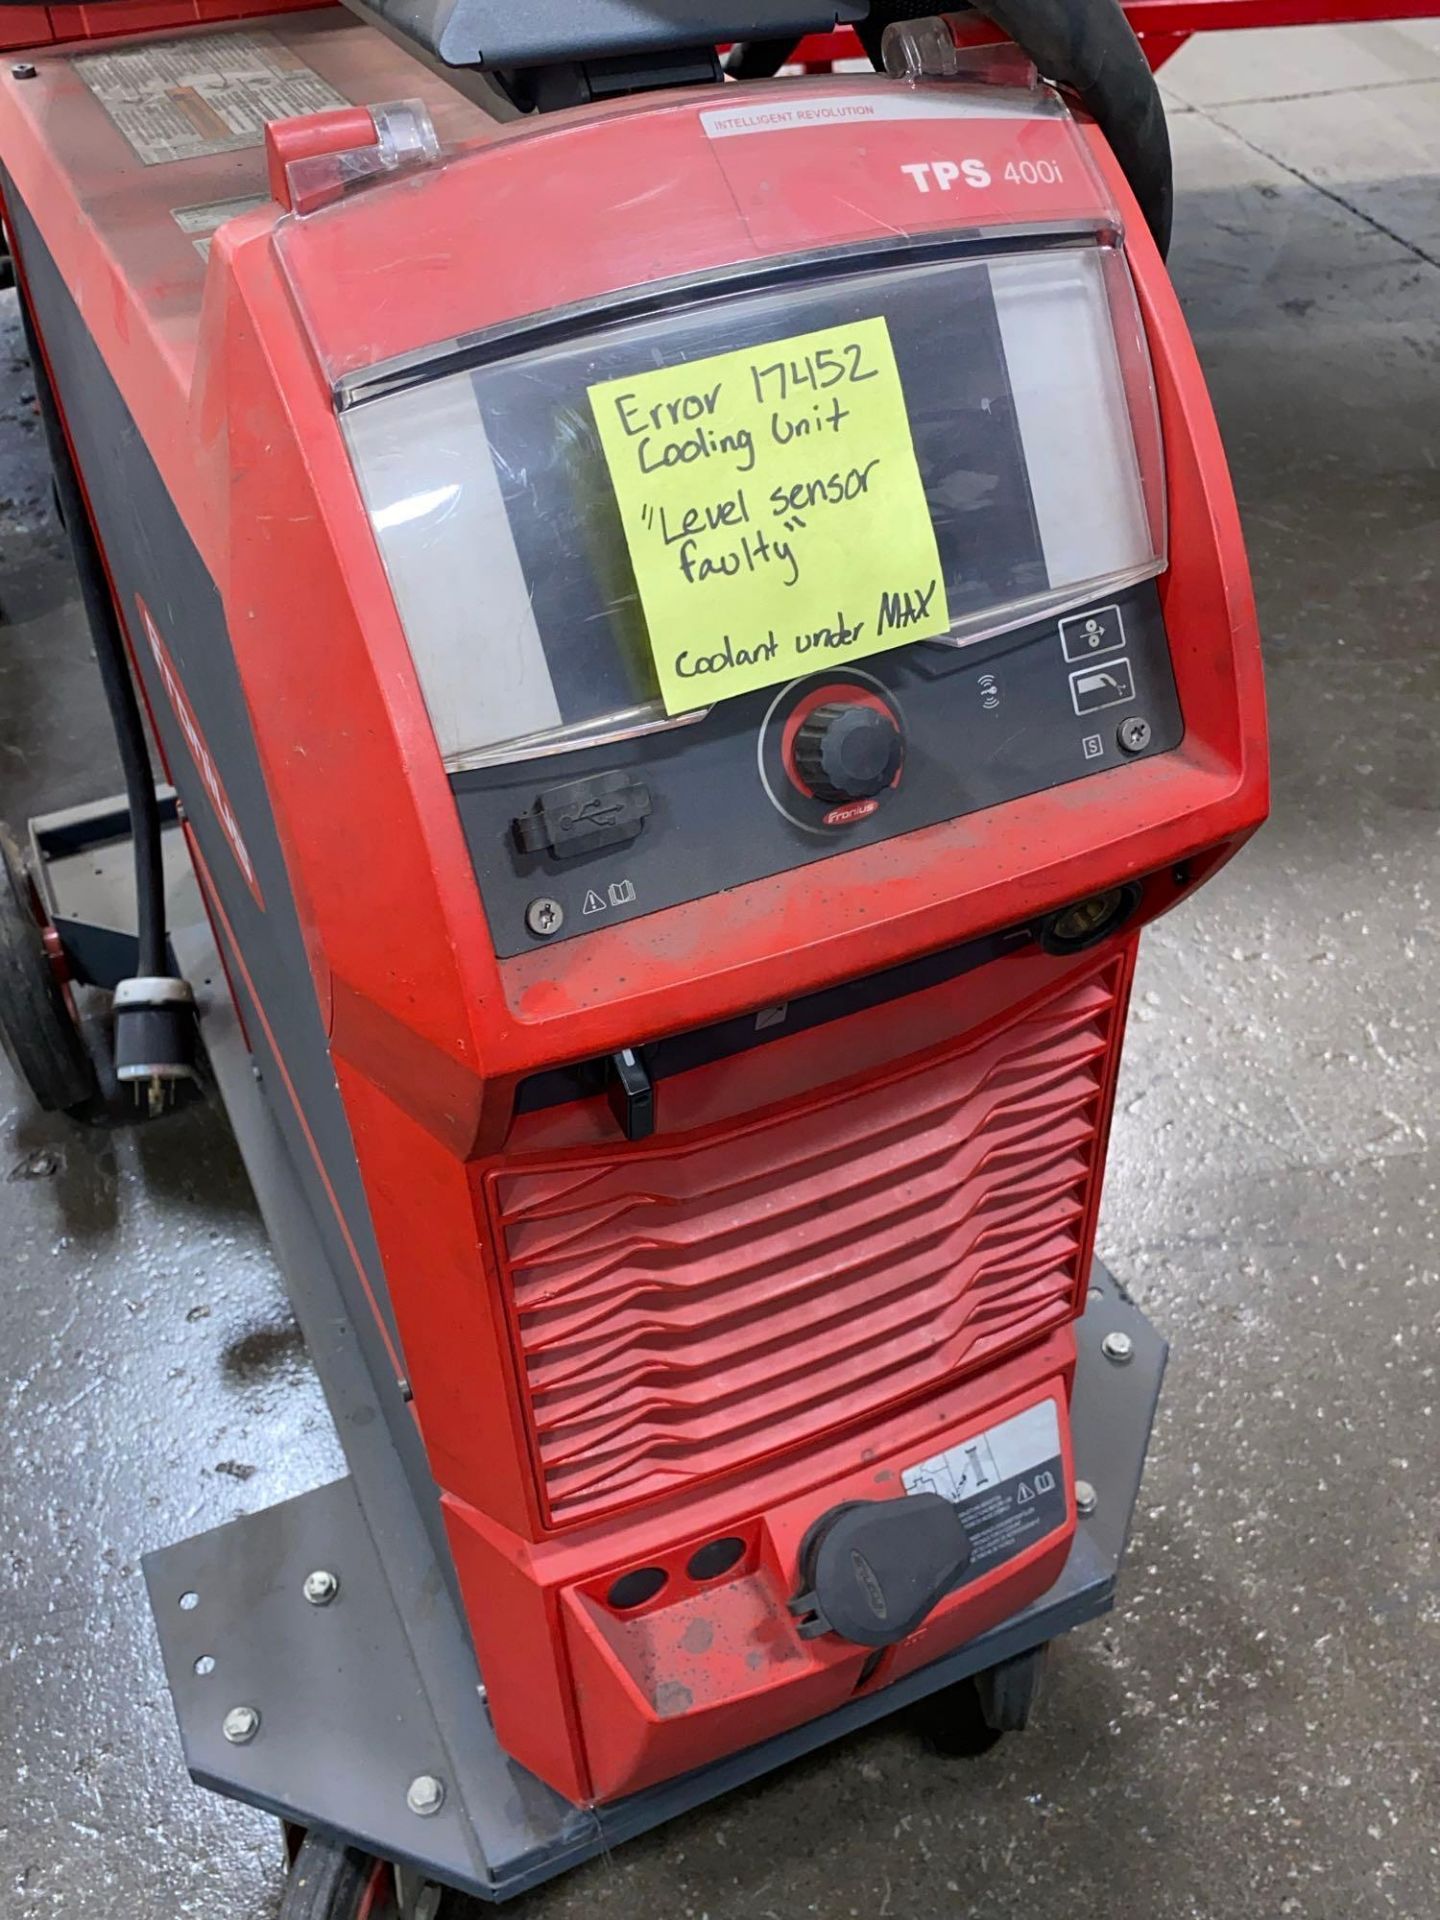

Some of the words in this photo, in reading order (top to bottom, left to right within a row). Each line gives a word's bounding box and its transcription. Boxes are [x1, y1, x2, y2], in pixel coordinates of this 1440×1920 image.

[714, 111, 793, 130] INTELLIGENT
[796, 105, 875, 121] REVOLUTION
[901, 158, 991, 193] TPS
[1003, 160, 1064, 185] 400i
[615, 383, 722, 436] Error
[751, 344, 878, 403] 17452
[638, 427, 755, 473] Cooling
[771, 398, 850, 444] Unit
[641, 489, 750, 545] "Level
[770, 459, 880, 516] sensor
[675, 631, 778, 678] Coolant
[796, 612, 864, 654] under
[877, 580, 936, 636] MAX
[1086, 739, 1099, 755] S
[828, 803, 875, 824] Fronius
